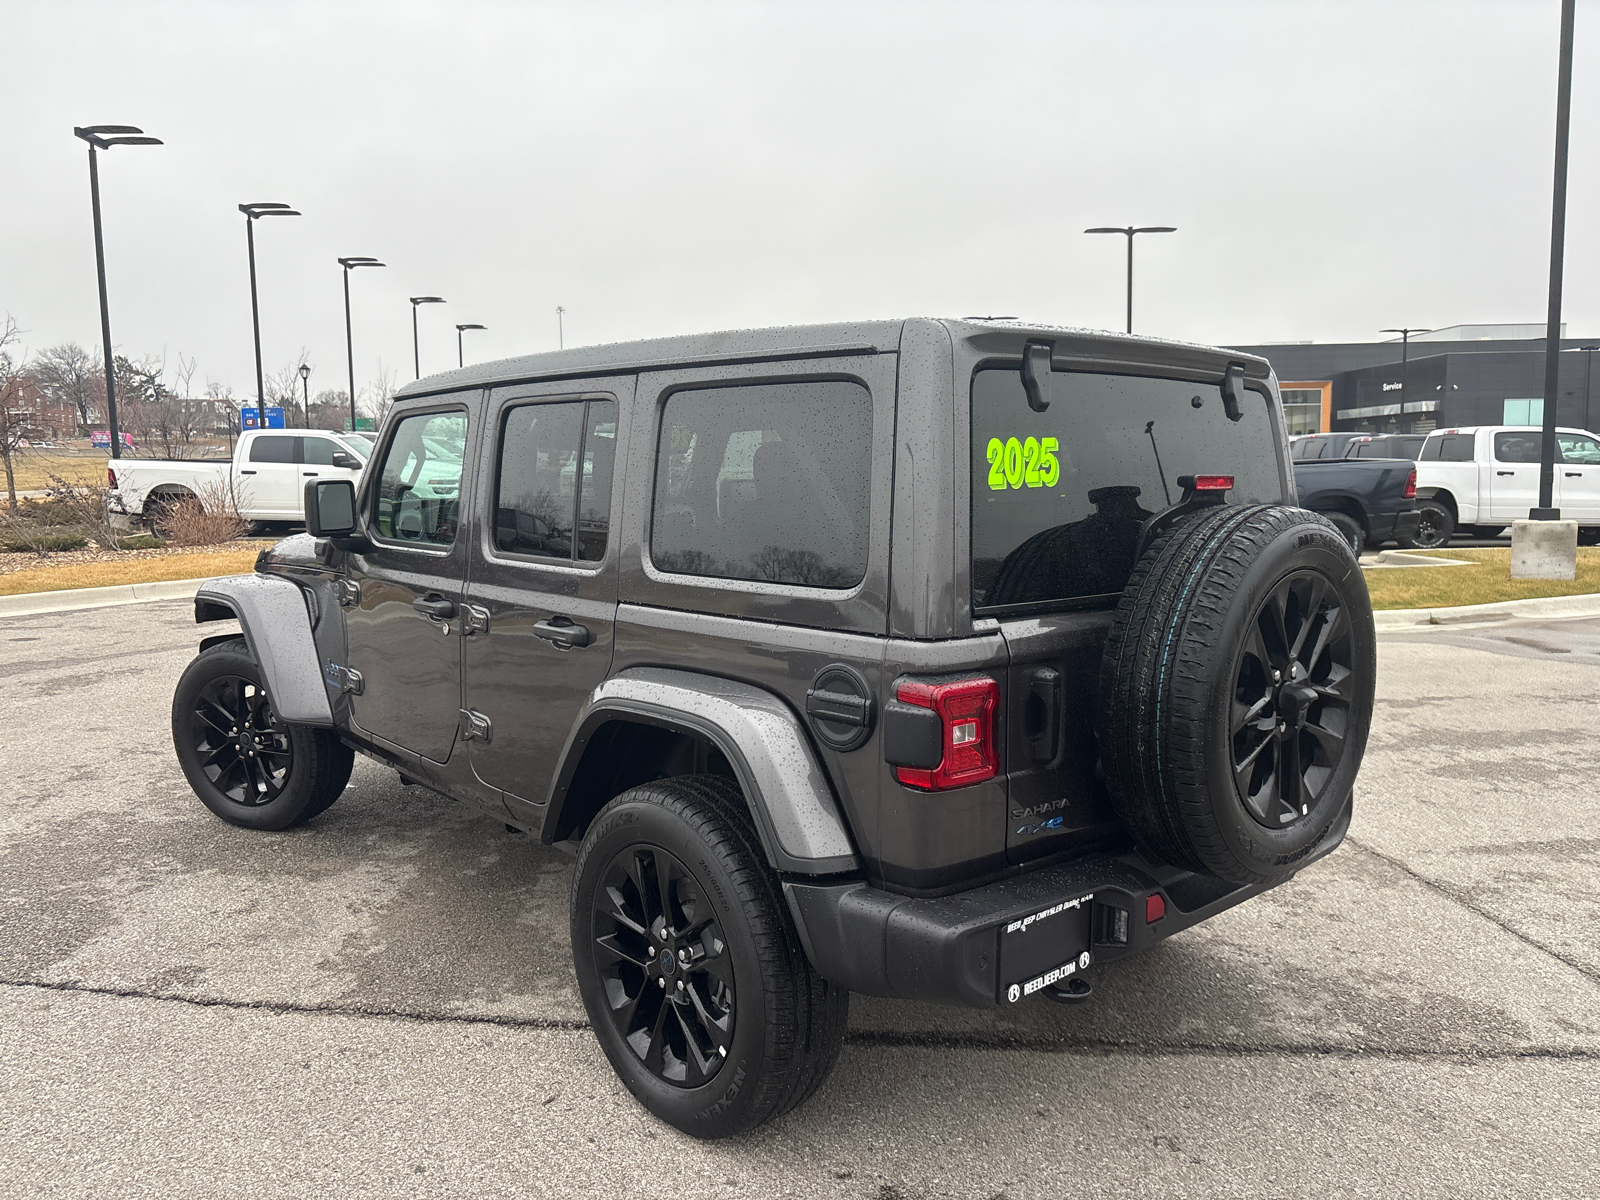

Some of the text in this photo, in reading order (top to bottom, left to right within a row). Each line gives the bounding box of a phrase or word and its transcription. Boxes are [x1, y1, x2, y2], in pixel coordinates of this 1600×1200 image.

[1382, 381, 1403, 392] Service
[986, 436, 1060, 490] 2025
[1011, 798, 1070, 820] SAHARA
[1007, 920, 1022, 934] REED
[1022, 914, 1036, 927] JEEP
[1036, 904, 1063, 921] CHRYSLER
[1024, 961, 1076, 996] REEDJEEP.COM
